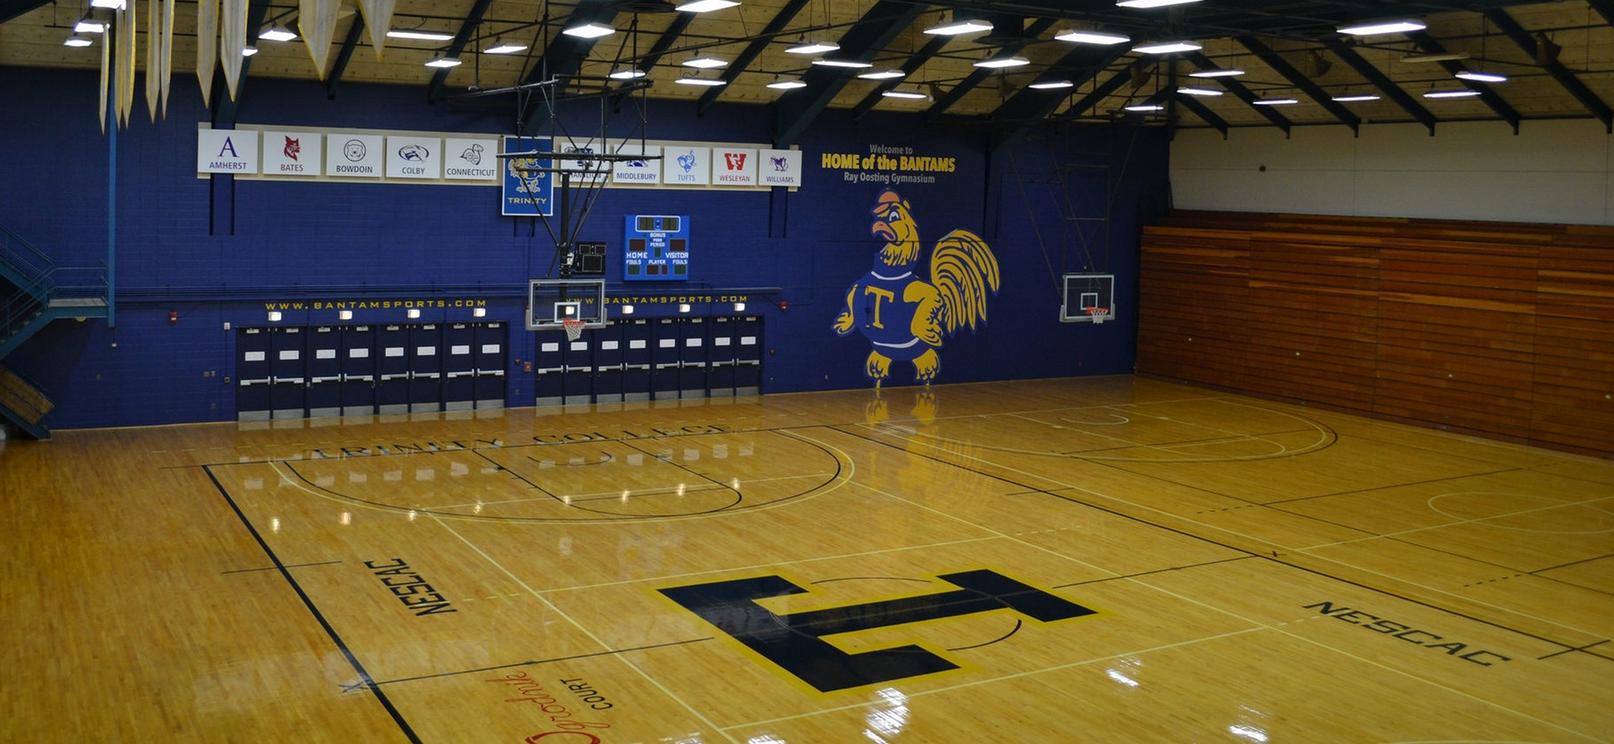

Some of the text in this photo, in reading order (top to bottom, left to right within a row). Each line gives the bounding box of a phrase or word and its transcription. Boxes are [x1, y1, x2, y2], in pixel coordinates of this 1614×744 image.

[219, 136, 238, 158] A
[869, 143, 913, 155] Welcome to
[208, 160, 247, 170] AMHERST
[280, 163, 304, 172] BATES
[724, 152, 747, 171] W
[821, 153, 956, 173] HOME of the BANTAMS
[335, 164, 373, 174] BOWDOIN
[401, 166, 425, 175] COLBY
[446, 167, 495, 177] CONNECTICUT
[616, 172, 657, 180] MIDDLEBURY
[677, 174, 696, 182] TUFTS
[719, 175, 751, 183] WESLEYAN
[766, 175, 794, 183] WILLIAMS
[843, 171, 936, 185] Ray Oosting Gymnasium
[865, 285, 895, 330] T
[363, 557, 458, 617] NESCAC
[656, 568, 1098, 692] T
[1302, 601, 1512, 667] NESCAC
[559, 677, 613, 711] COURT
